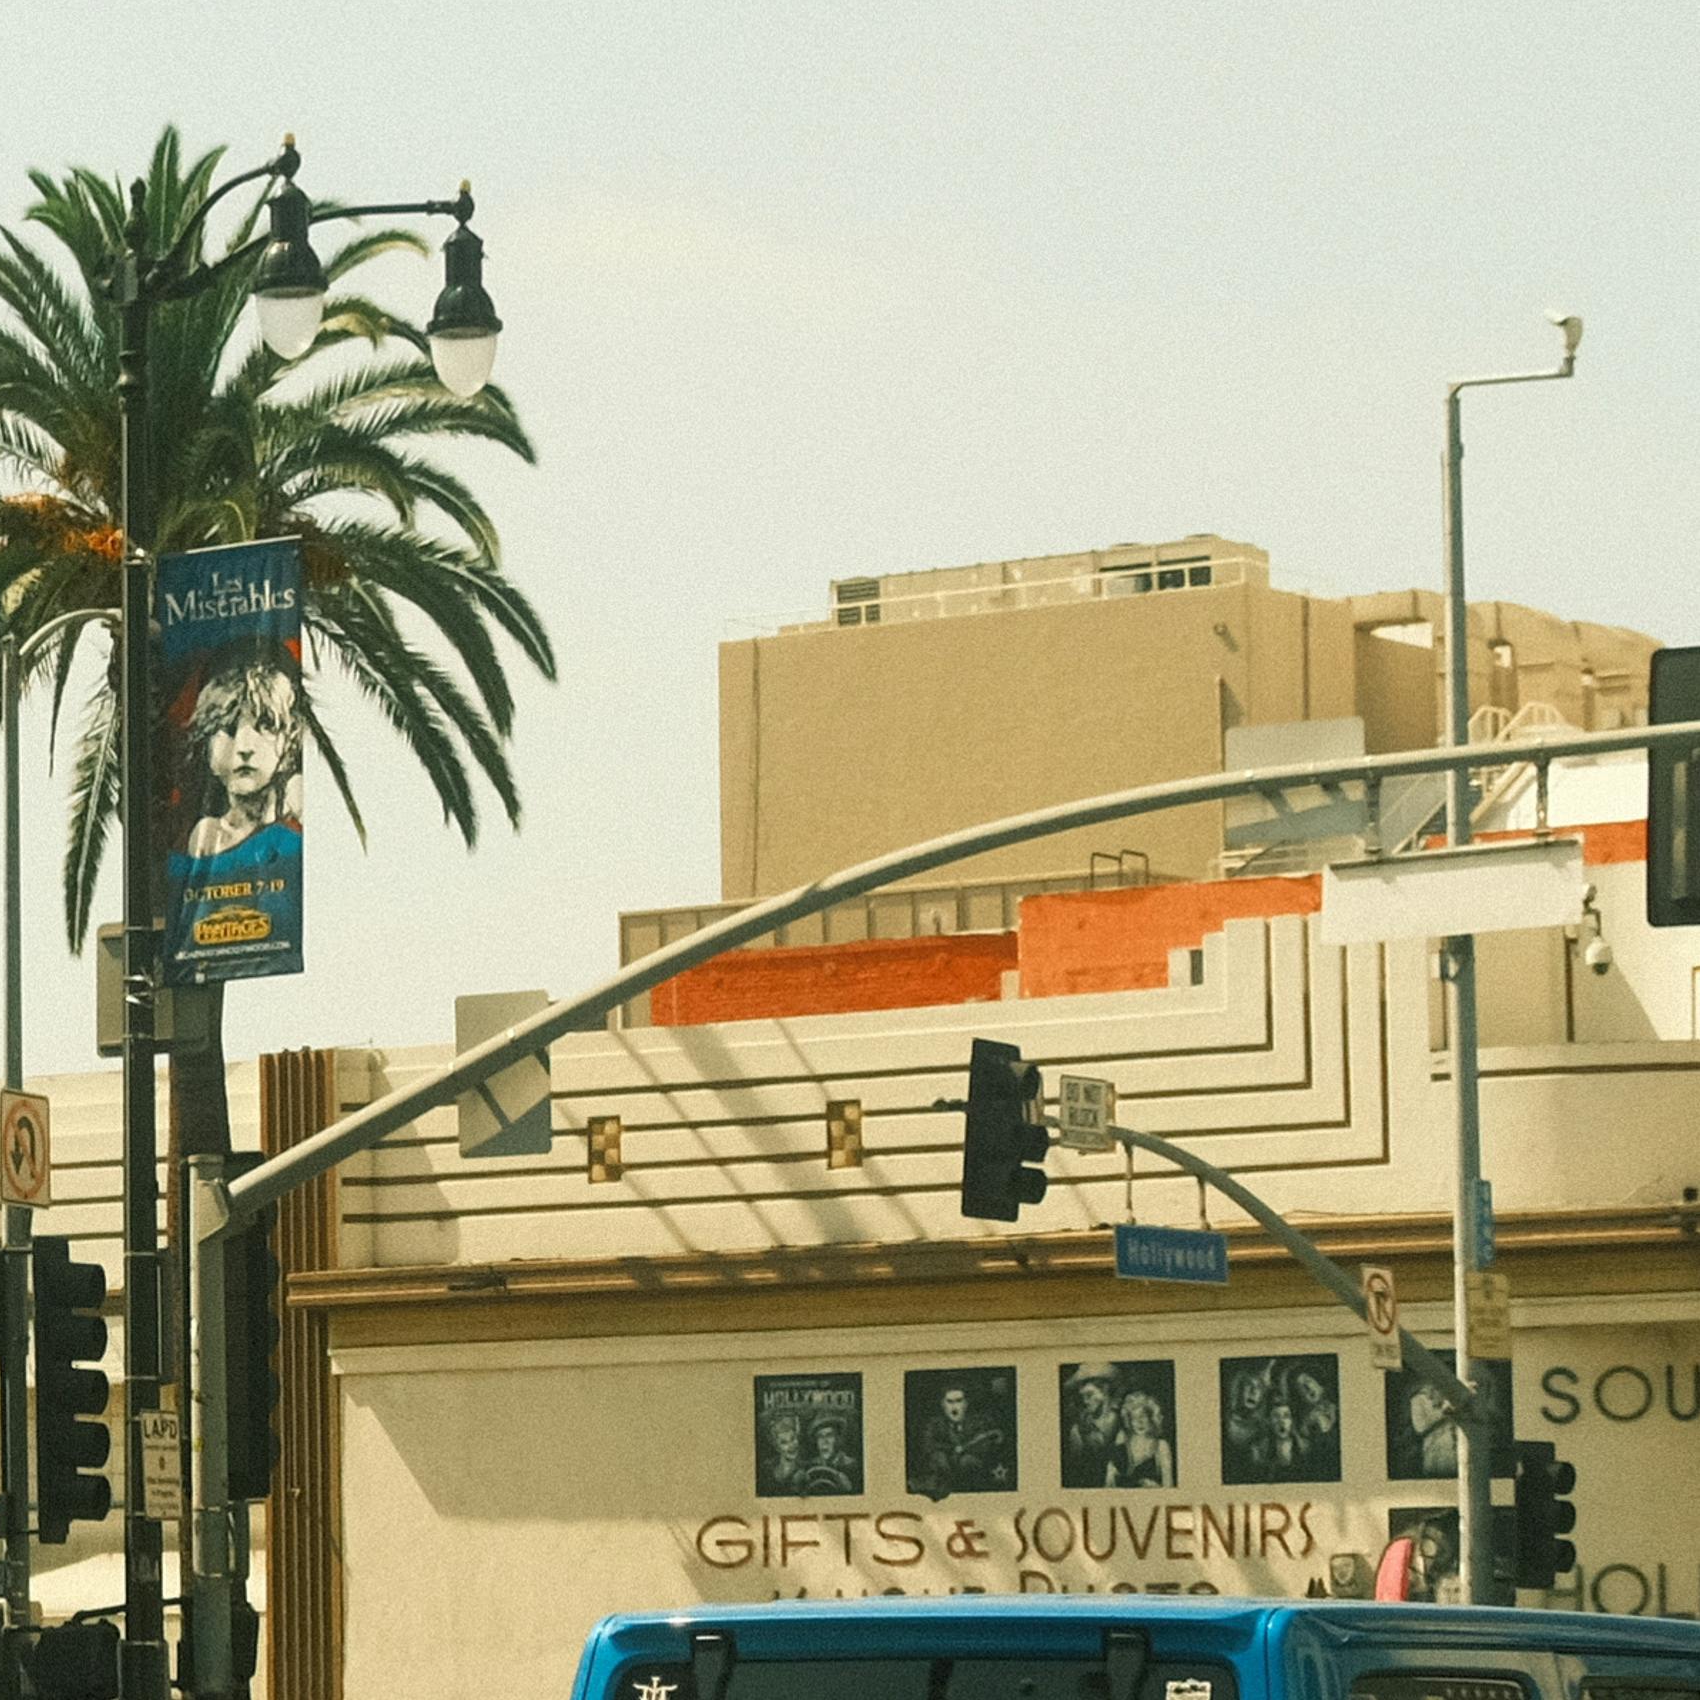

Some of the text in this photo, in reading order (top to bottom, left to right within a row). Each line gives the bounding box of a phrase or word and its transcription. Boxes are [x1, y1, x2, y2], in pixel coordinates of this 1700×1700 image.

[144, 1418, 178, 1439] LAPD
[695, 1502, 1316, 1570] GIFTS & SOUVENIRS
